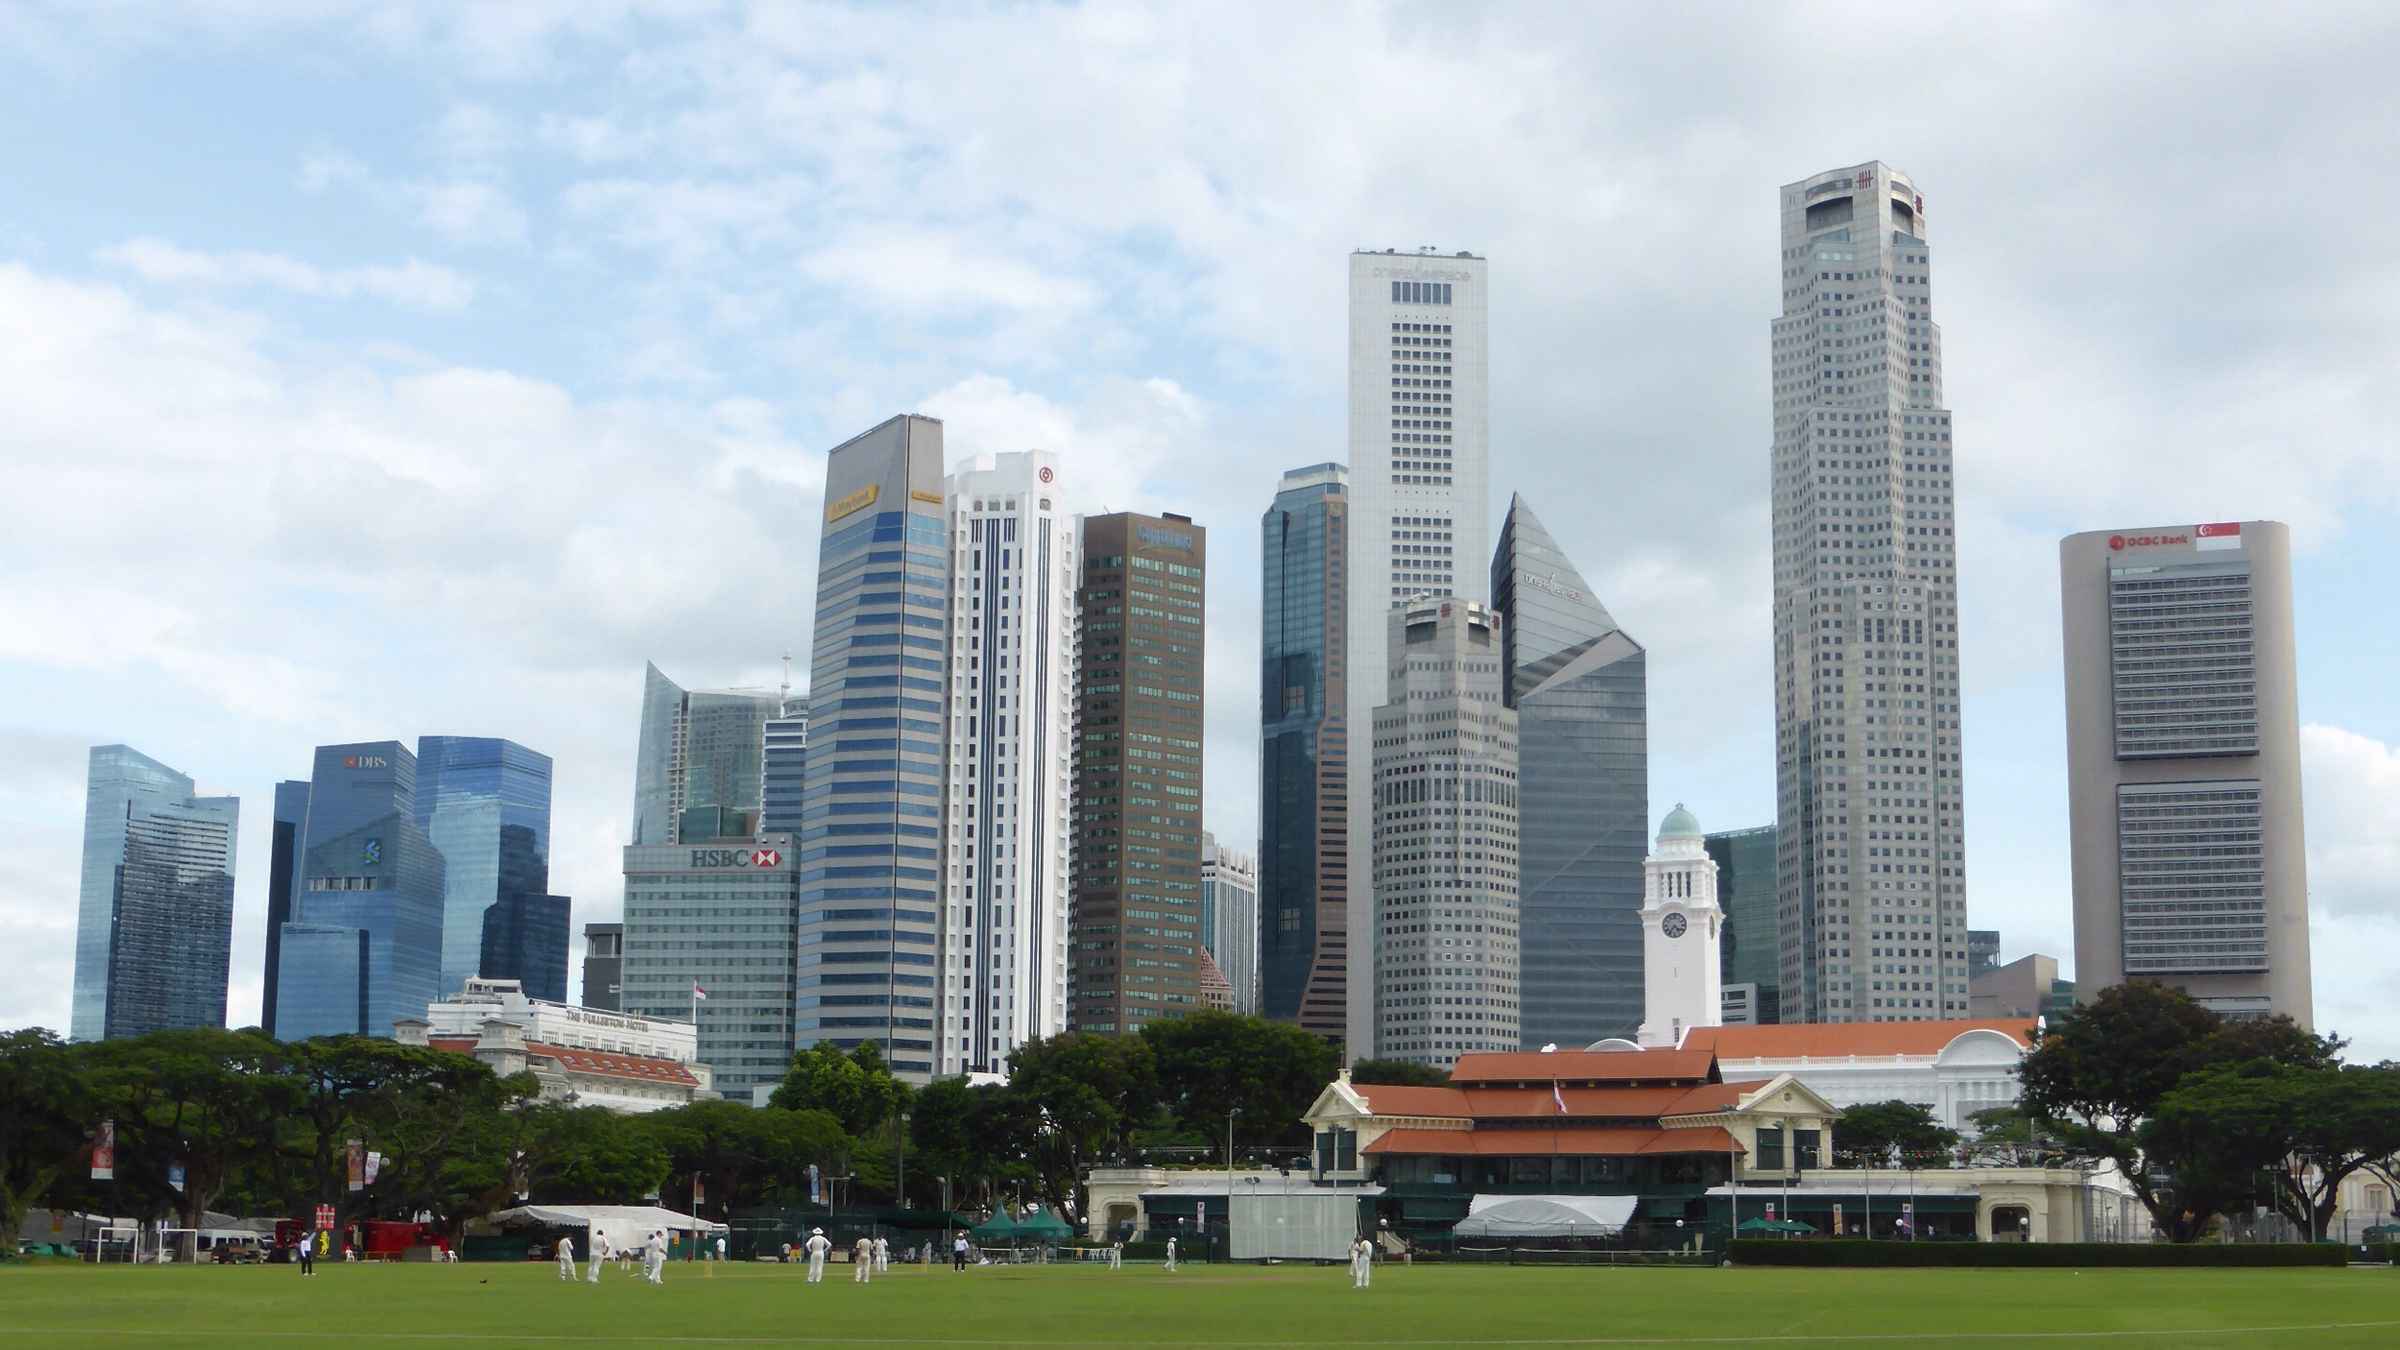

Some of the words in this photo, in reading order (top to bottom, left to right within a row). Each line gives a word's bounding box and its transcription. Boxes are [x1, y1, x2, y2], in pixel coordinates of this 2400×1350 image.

[2127, 536, 2160, 546] OCBC
[2160, 534, 2188, 545] Bank
[359, 756, 386, 768] DBS
[691, 849, 749, 867] HSBC
[566, 1009, 581, 1022] THE
[626, 1020, 649, 1032] HOTEL
